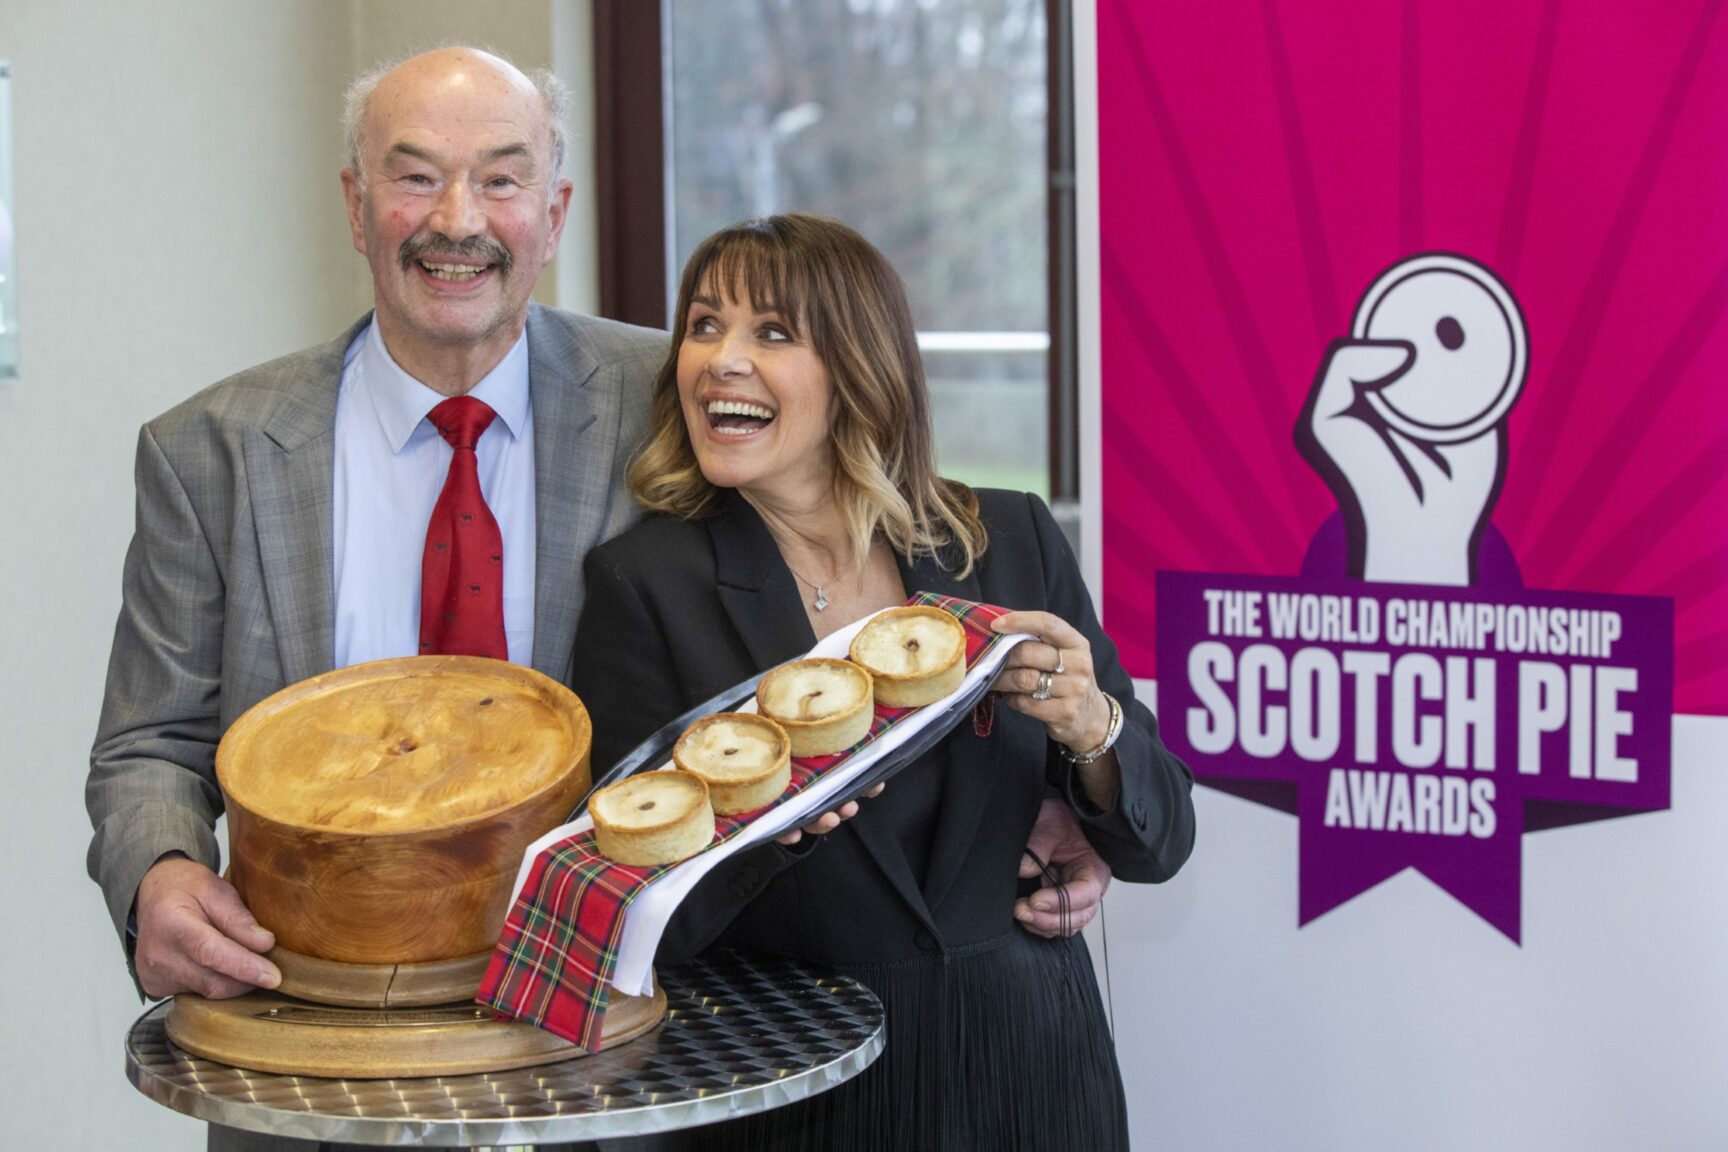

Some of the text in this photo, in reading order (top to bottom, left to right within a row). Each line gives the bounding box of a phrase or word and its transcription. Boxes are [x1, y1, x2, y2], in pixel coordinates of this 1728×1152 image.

[1203, 589, 1622, 658] THE WORLD CHAMPIONSHIP
[1186, 640, 1639, 783] SCOTCH PIE
[1324, 768, 1497, 838] AWARDS
